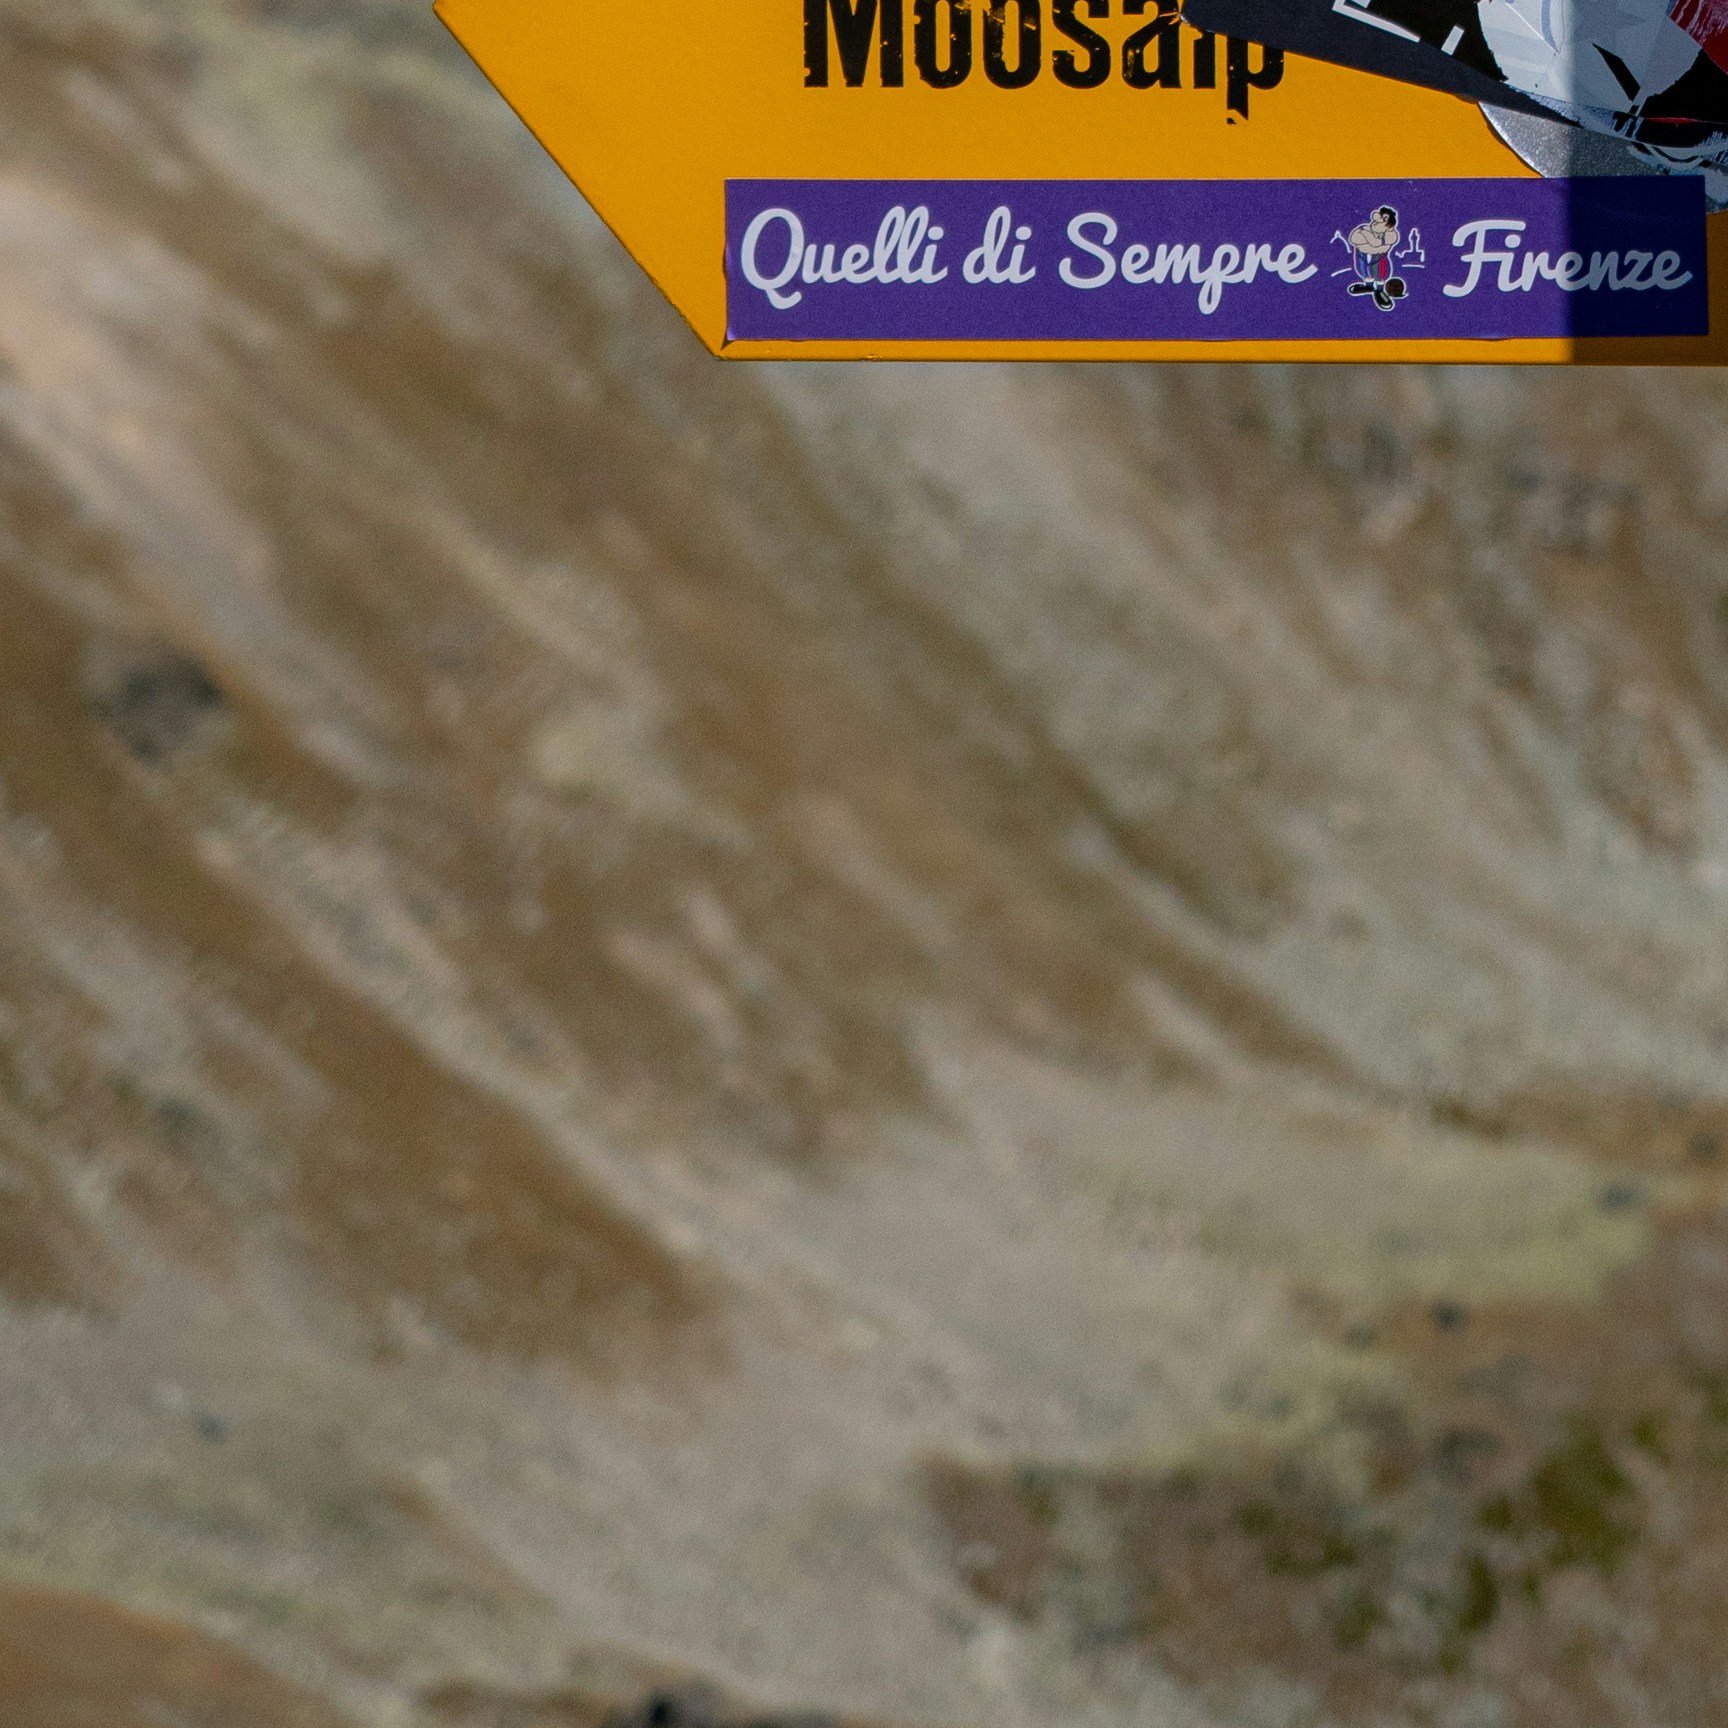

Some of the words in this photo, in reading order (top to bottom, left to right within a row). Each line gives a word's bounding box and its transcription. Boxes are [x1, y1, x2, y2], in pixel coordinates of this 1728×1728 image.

[740, 206, 949, 311] Quelli
[961, 204, 1037, 286] di
[1057, 211, 1318, 314] Sempre
[1441, 219, 1694, 297] Firenze
